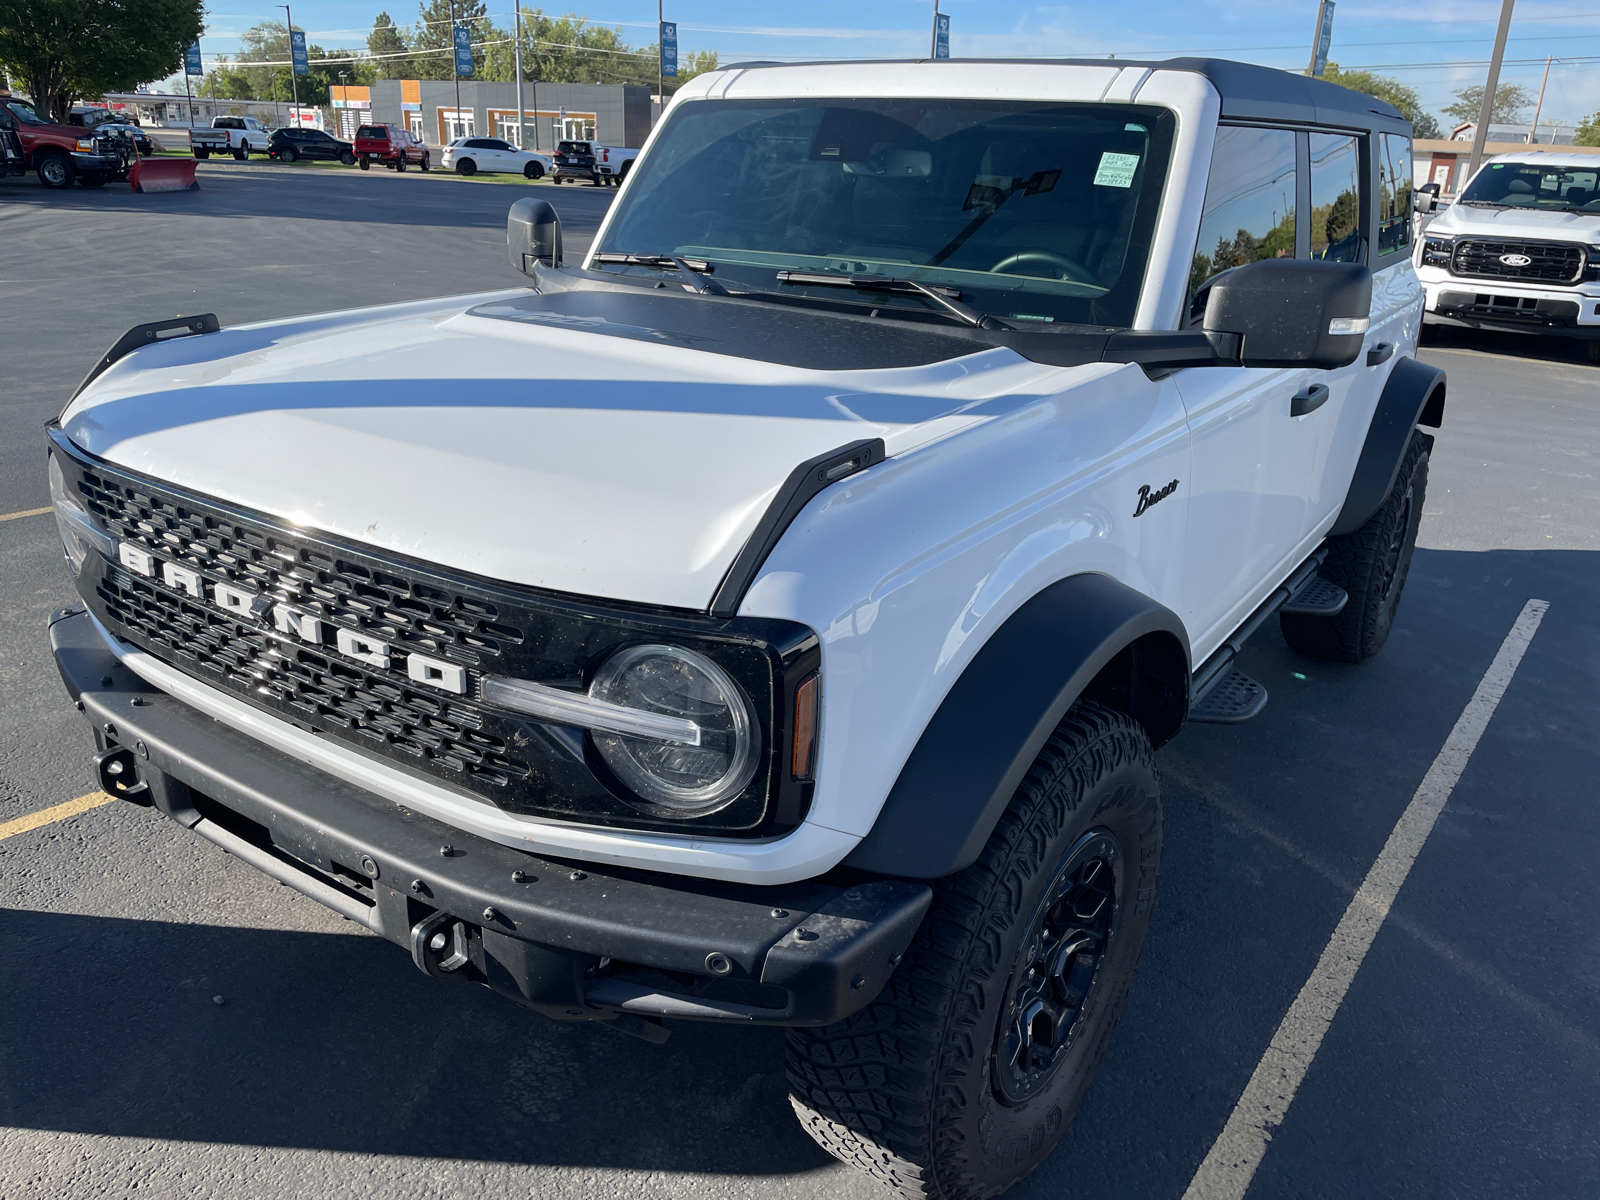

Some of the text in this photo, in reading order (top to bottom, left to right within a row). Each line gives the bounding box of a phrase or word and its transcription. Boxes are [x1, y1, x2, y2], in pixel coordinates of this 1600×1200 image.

[1503, 256, 1529, 265] Ford
[1133, 479, 1180, 517] Bronco
[119, 541, 467, 695] BRONCO
